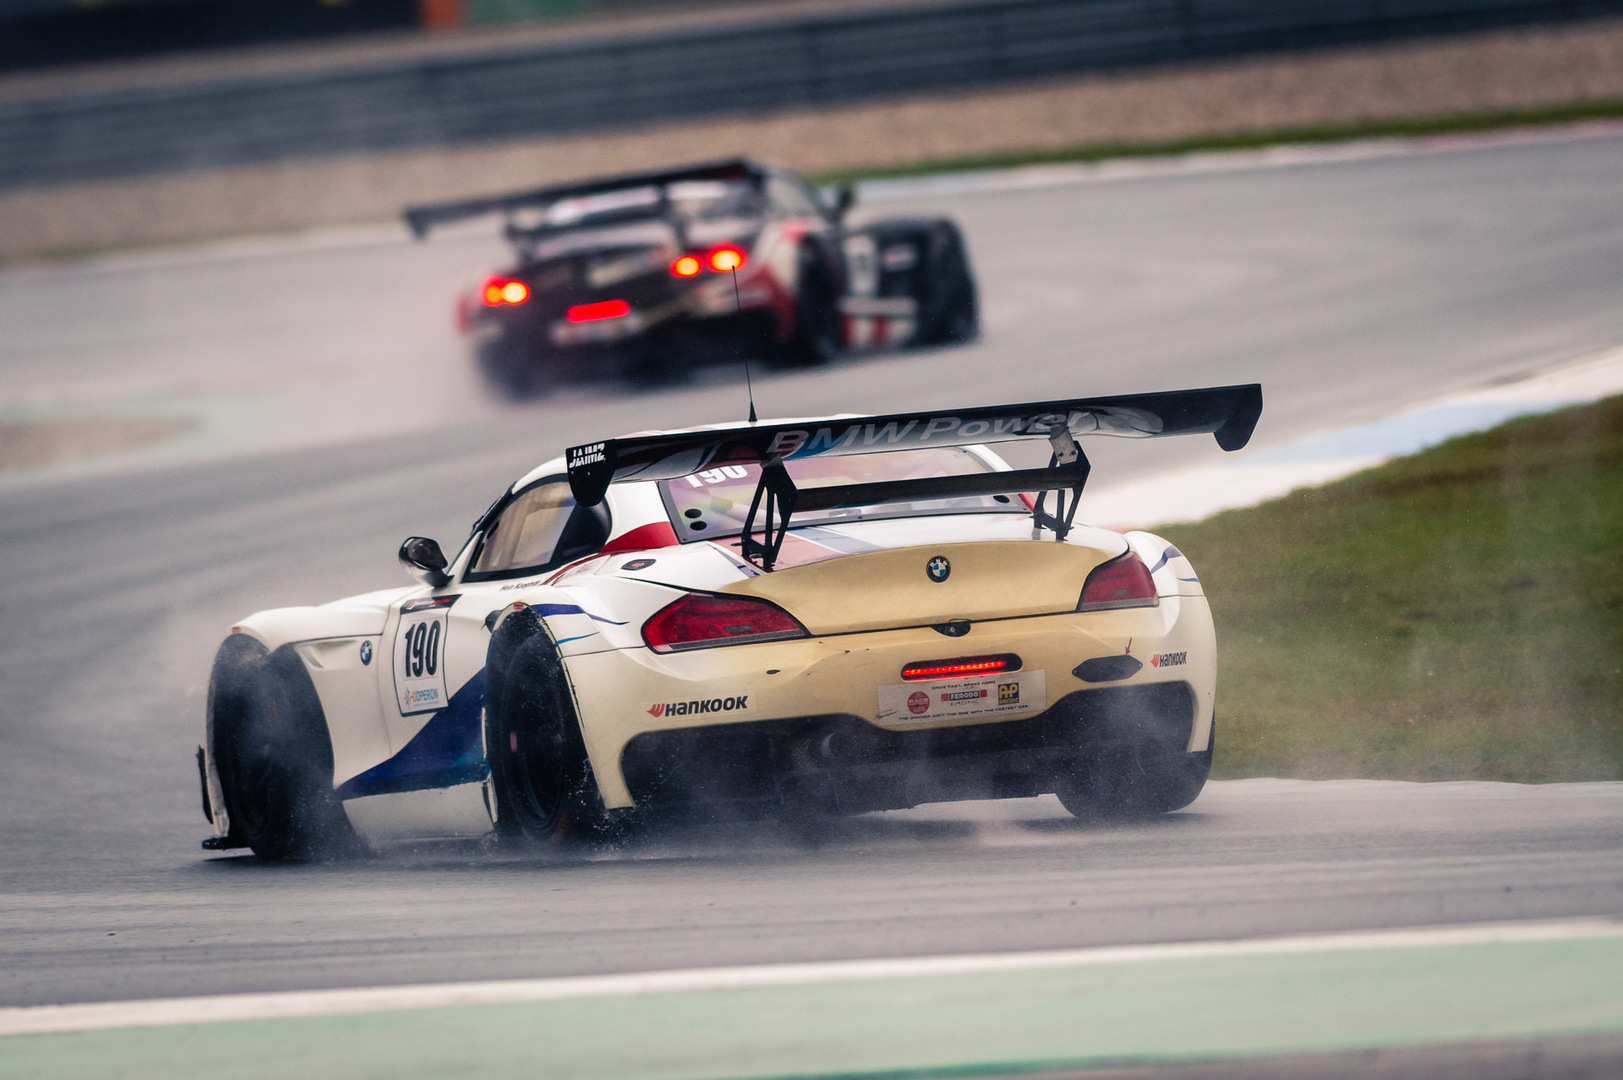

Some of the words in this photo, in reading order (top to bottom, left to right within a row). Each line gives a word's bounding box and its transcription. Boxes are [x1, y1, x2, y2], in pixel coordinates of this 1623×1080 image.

[766, 420, 919, 454] BMW
[920, 411, 1092, 440] Power
[685, 464, 748, 488] 190
[405, 620, 441, 678] 190
[1160, 651, 1187, 667] HANKOOK
[950, 692, 979, 700] FERODO
[999, 683, 1018, 699] AP
[665, 696, 748, 717] HANKOOK
